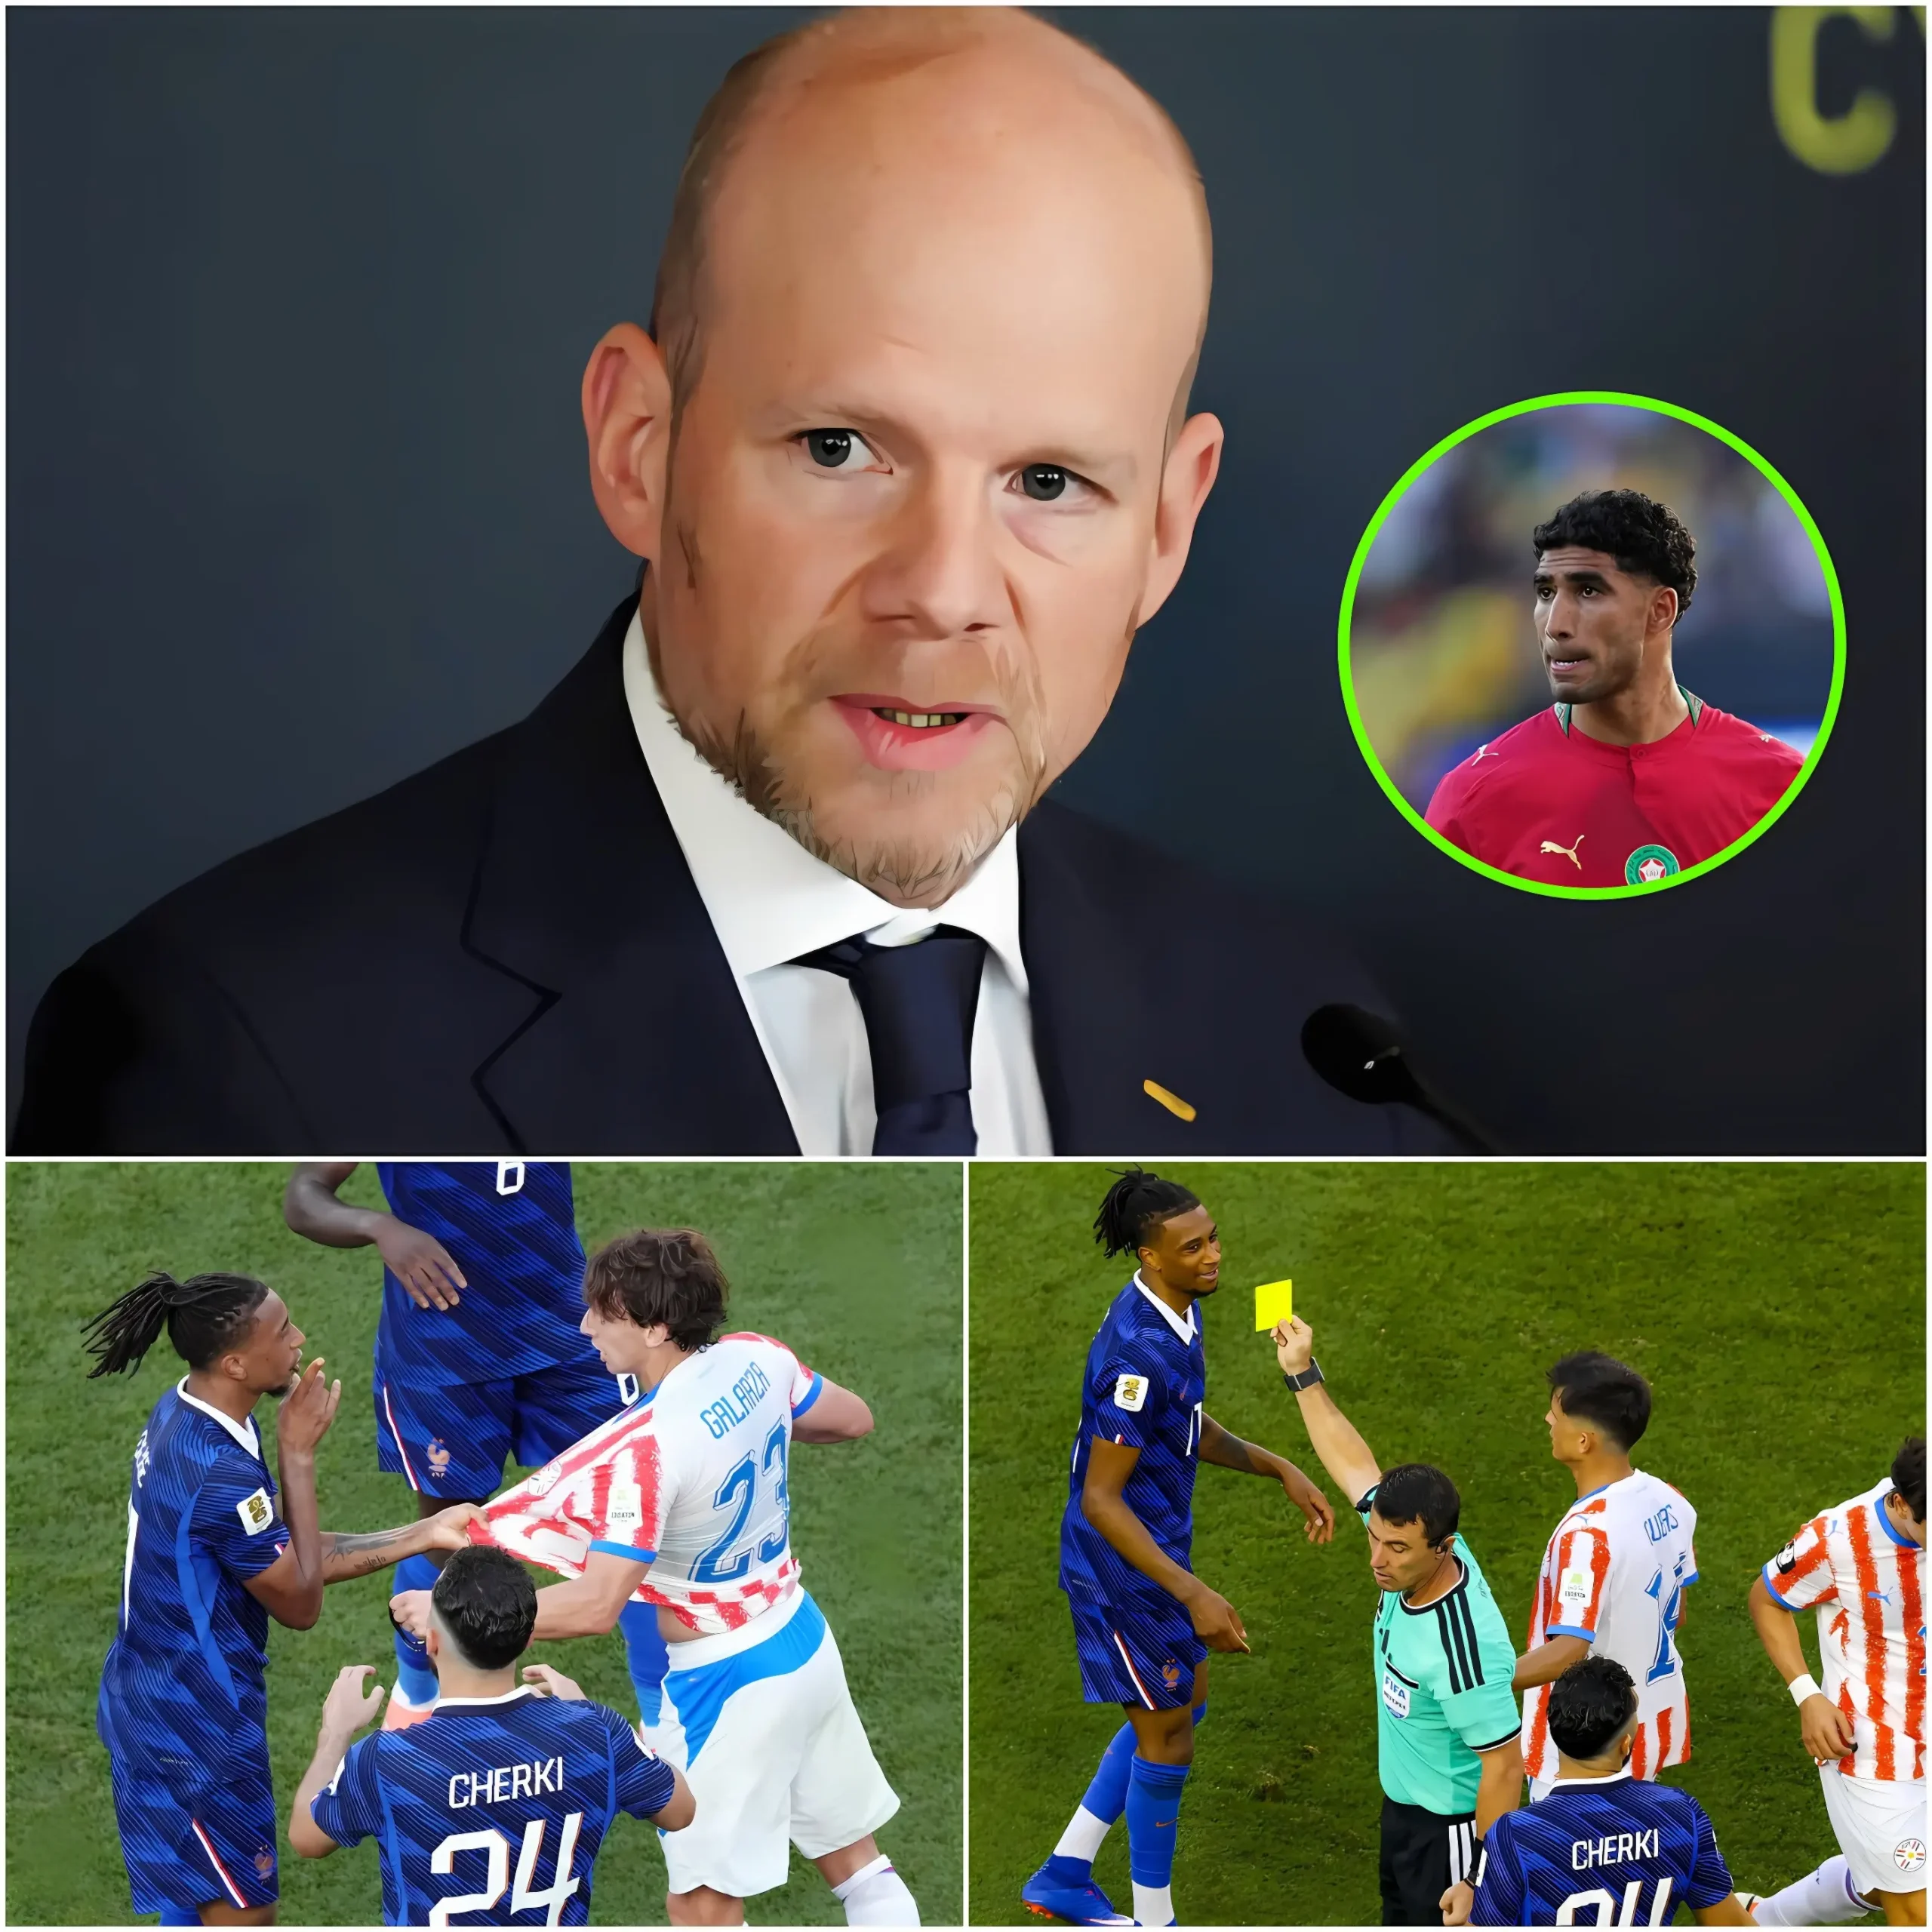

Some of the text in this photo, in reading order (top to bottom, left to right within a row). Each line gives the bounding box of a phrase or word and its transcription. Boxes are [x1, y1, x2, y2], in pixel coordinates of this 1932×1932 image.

[1769, 6, 1926, 175] C
[688, 1414, 789, 1583] 23
[1385, 1675, 1407, 1700] FIFA
[448, 1756, 563, 1809] CHERKI
[428, 1811, 584, 1926] 24
[1572, 1828, 1659, 1870] CHERKI
